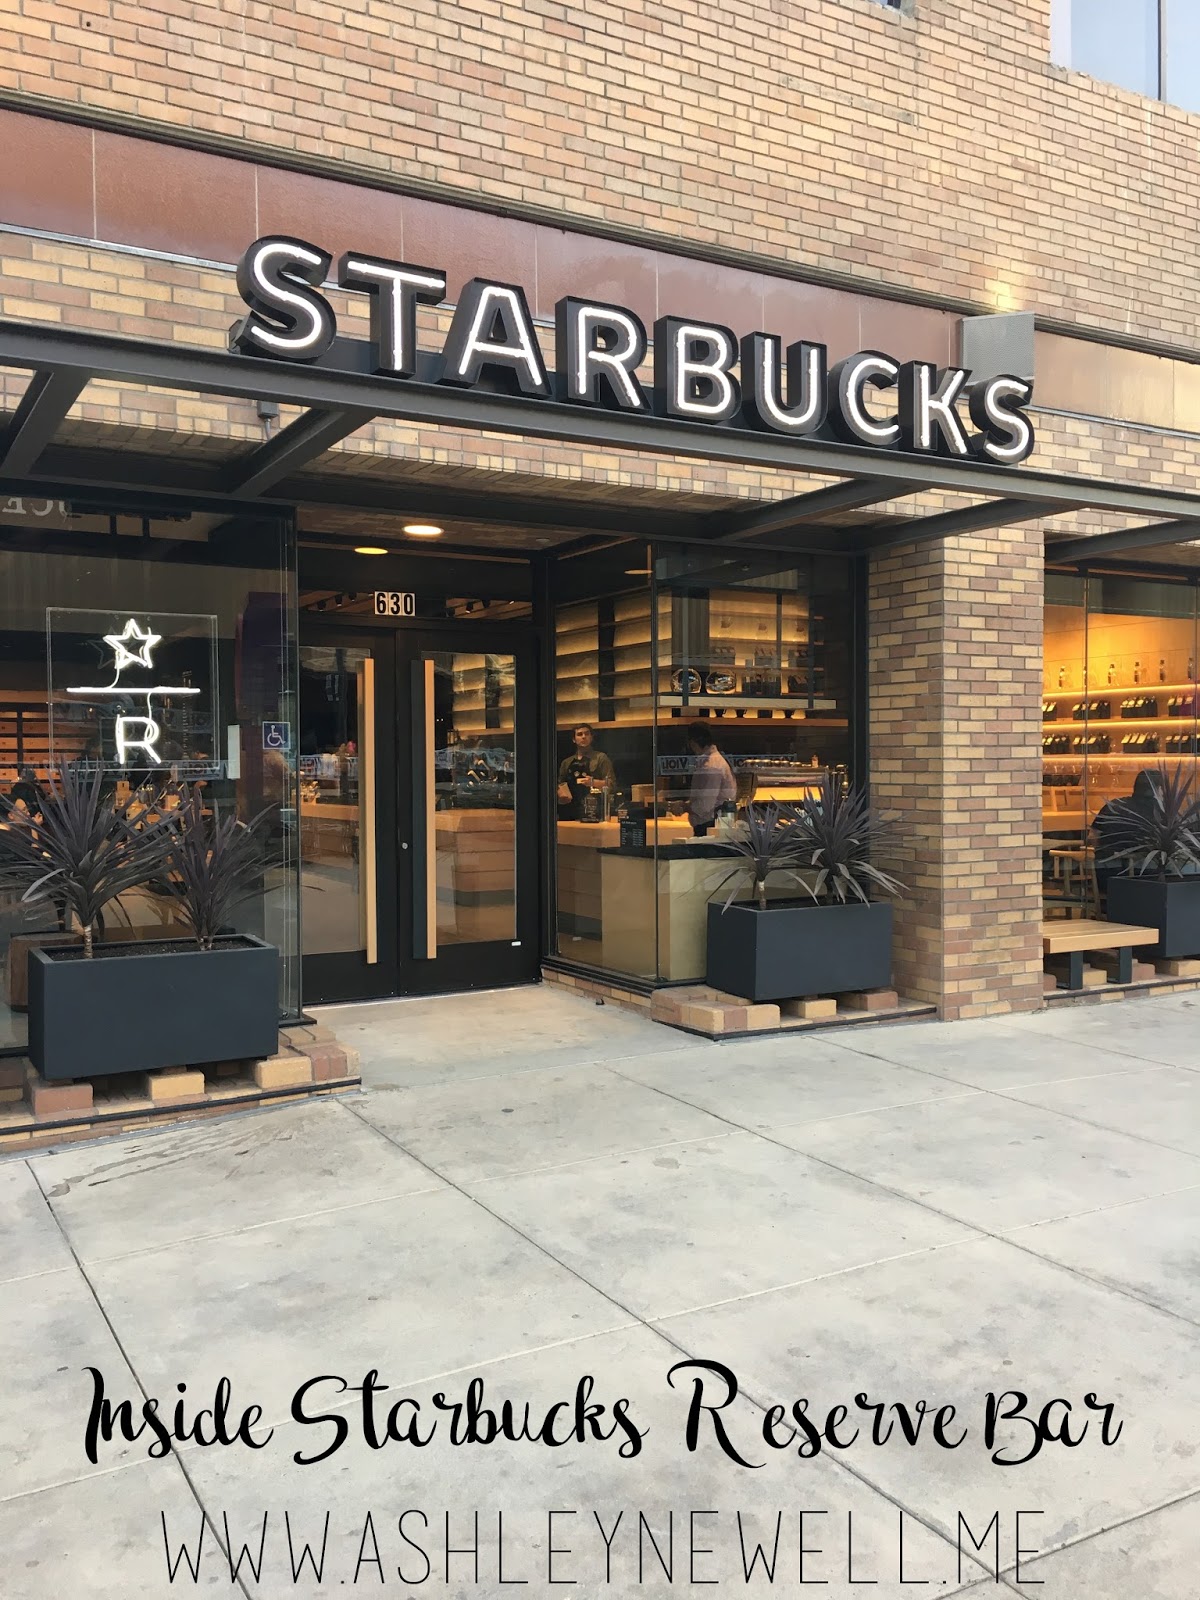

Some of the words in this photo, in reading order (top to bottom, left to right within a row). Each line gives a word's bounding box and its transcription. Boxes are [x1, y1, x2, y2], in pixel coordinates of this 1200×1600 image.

[236, 235, 1036, 466] STARBUCKS
[375, 592, 415, 616] 630
[115, 713, 162, 765] R
